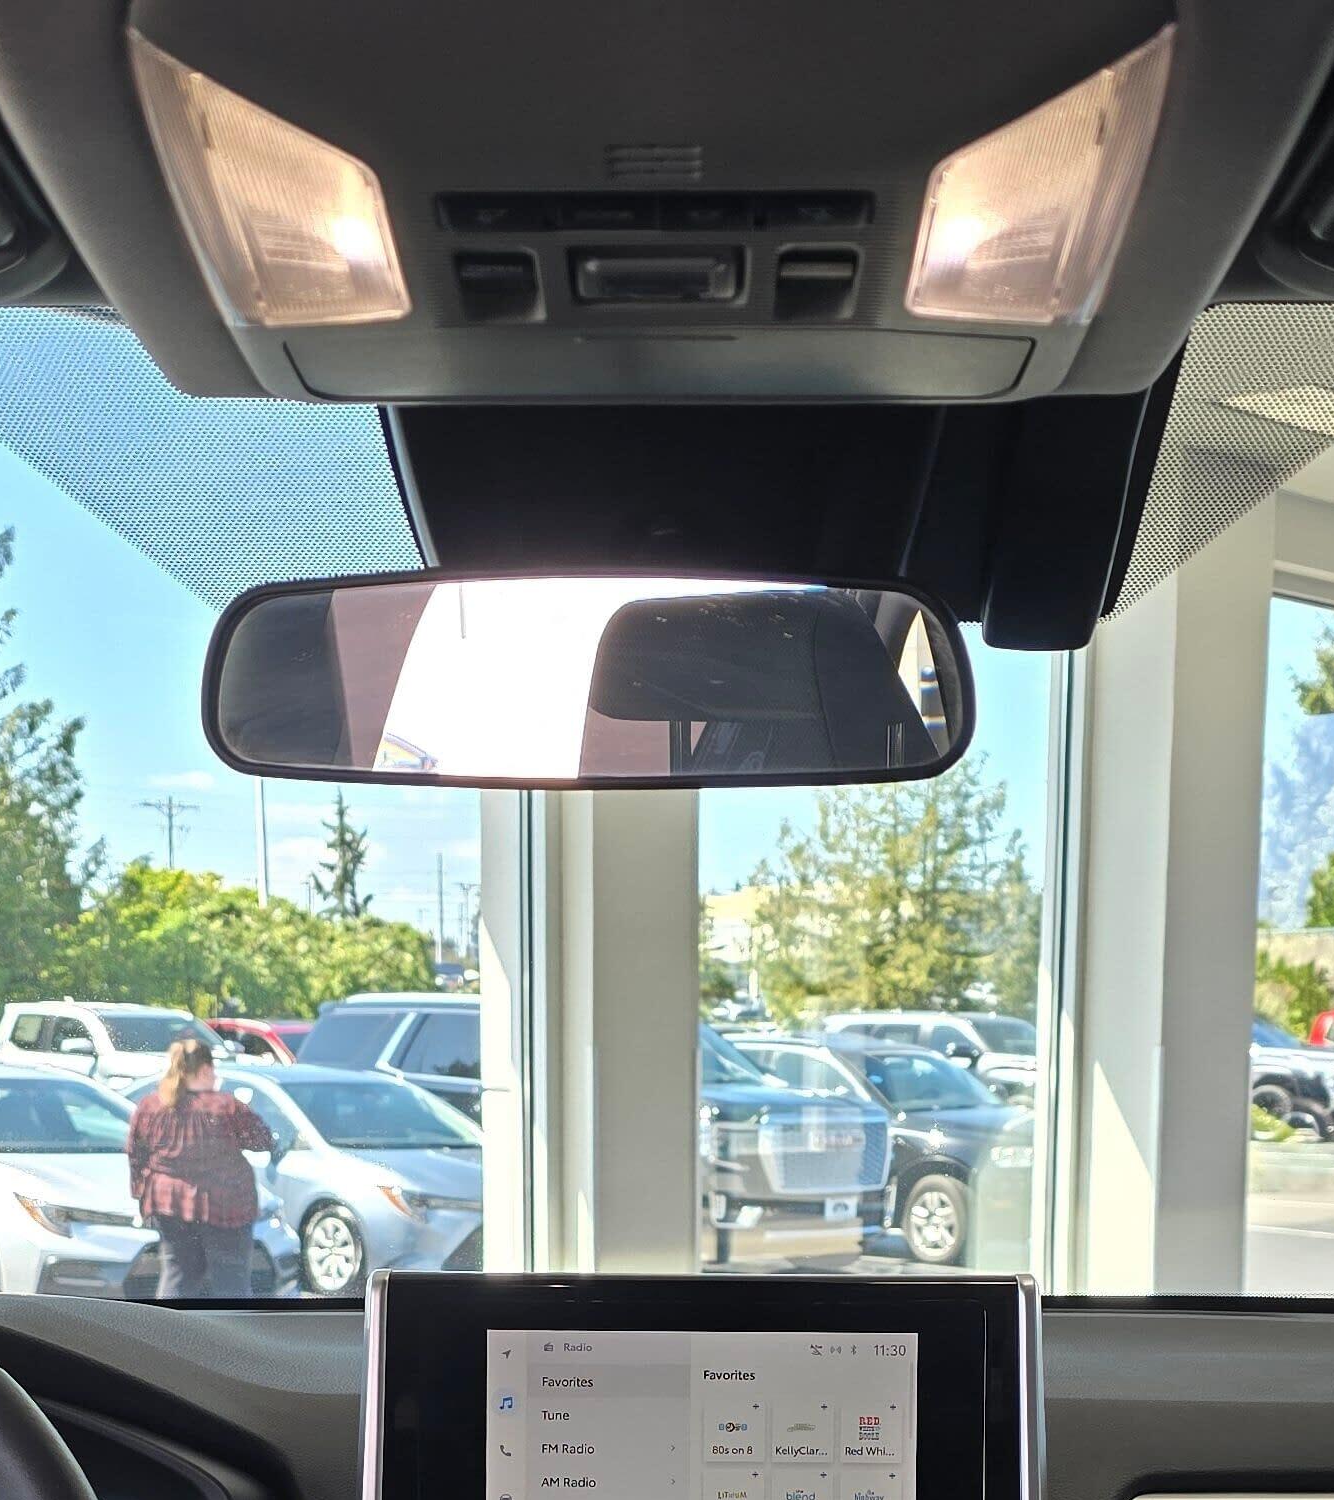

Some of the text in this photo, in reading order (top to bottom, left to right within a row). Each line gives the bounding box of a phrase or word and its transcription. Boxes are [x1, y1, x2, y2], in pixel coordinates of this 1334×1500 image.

[563, 1343, 593, 1352] Radio
[873, 1344, 907, 1357] 11:30
[703, 1370, 756, 1381] Favorites
[541, 1376, 594, 1388] Favorites
[541, 1410, 570, 1421] Tune
[541, 1443, 595, 1455] FM Radio
[732, 1447, 745, 1455] on
[746, 1446, 753, 1455] 8
[845, 1447, 864, 1456] Red
[541, 1477, 596, 1488] AM Radio
